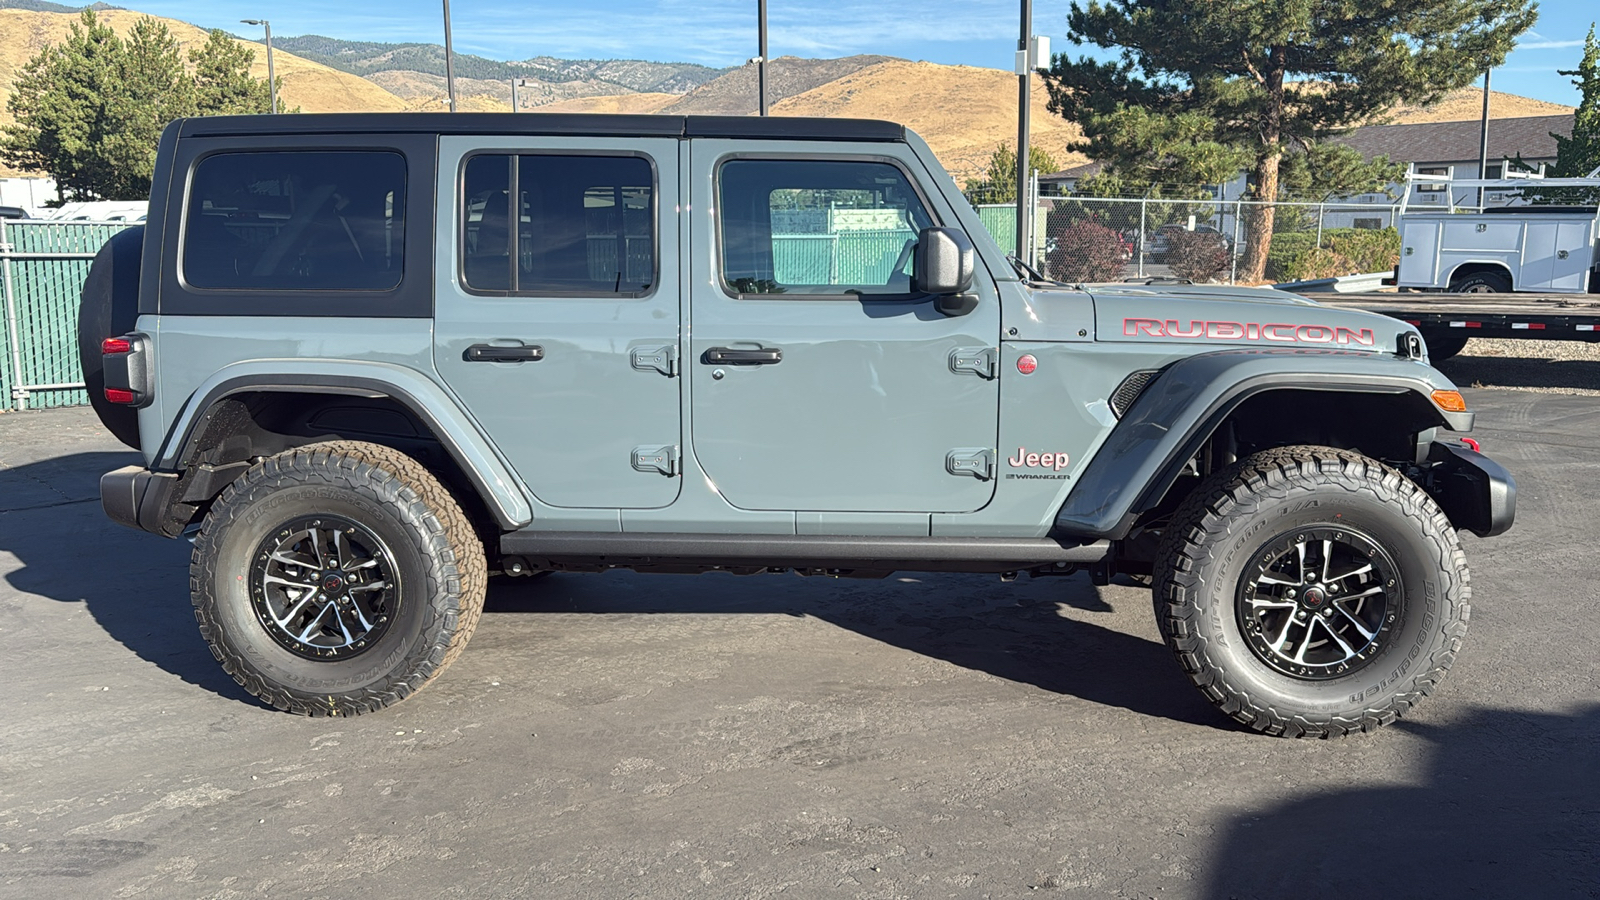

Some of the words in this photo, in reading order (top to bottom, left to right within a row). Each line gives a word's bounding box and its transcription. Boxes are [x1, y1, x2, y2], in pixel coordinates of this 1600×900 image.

[1122, 317, 1376, 347] RUBICON
[1008, 447, 1070, 471] Jeep
[1277, 499, 1321, 517] T/A
[1349, 580, 1436, 704] BFGoodrich
